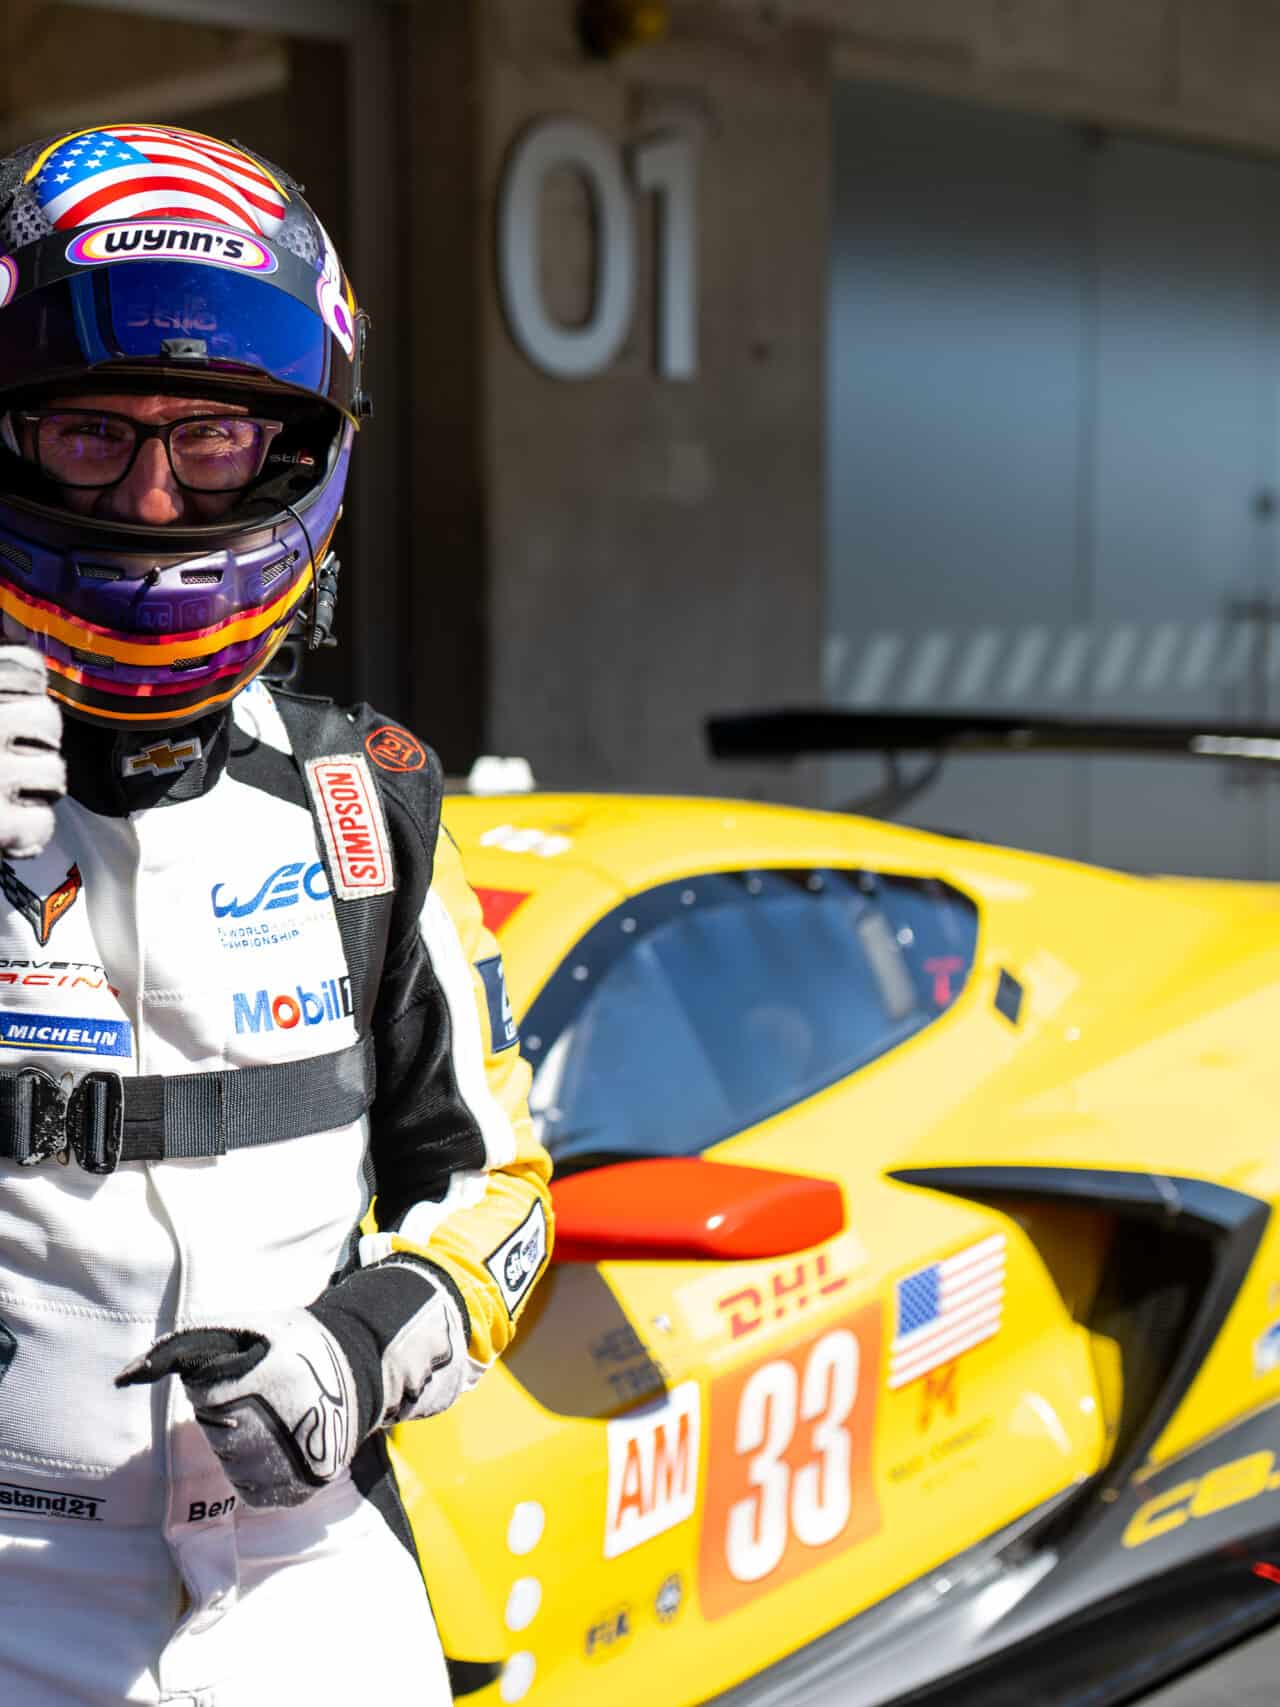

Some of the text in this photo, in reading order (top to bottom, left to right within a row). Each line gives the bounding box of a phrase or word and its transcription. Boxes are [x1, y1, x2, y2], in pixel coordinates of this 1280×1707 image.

[105, 229, 244, 258] wynn's
[501, 118, 699, 383] 01
[325, 773, 377, 879] SIMPSON
[211, 862, 332, 917] WEC
[7, 1024, 118, 1046] MICHELIN
[233, 979, 340, 1034] Mobil
[719, 1255, 847, 1340] DHL
[615, 1413, 691, 1533] AM
[725, 1329, 860, 1582] 33
[188, 1496, 235, 1522] Ben
